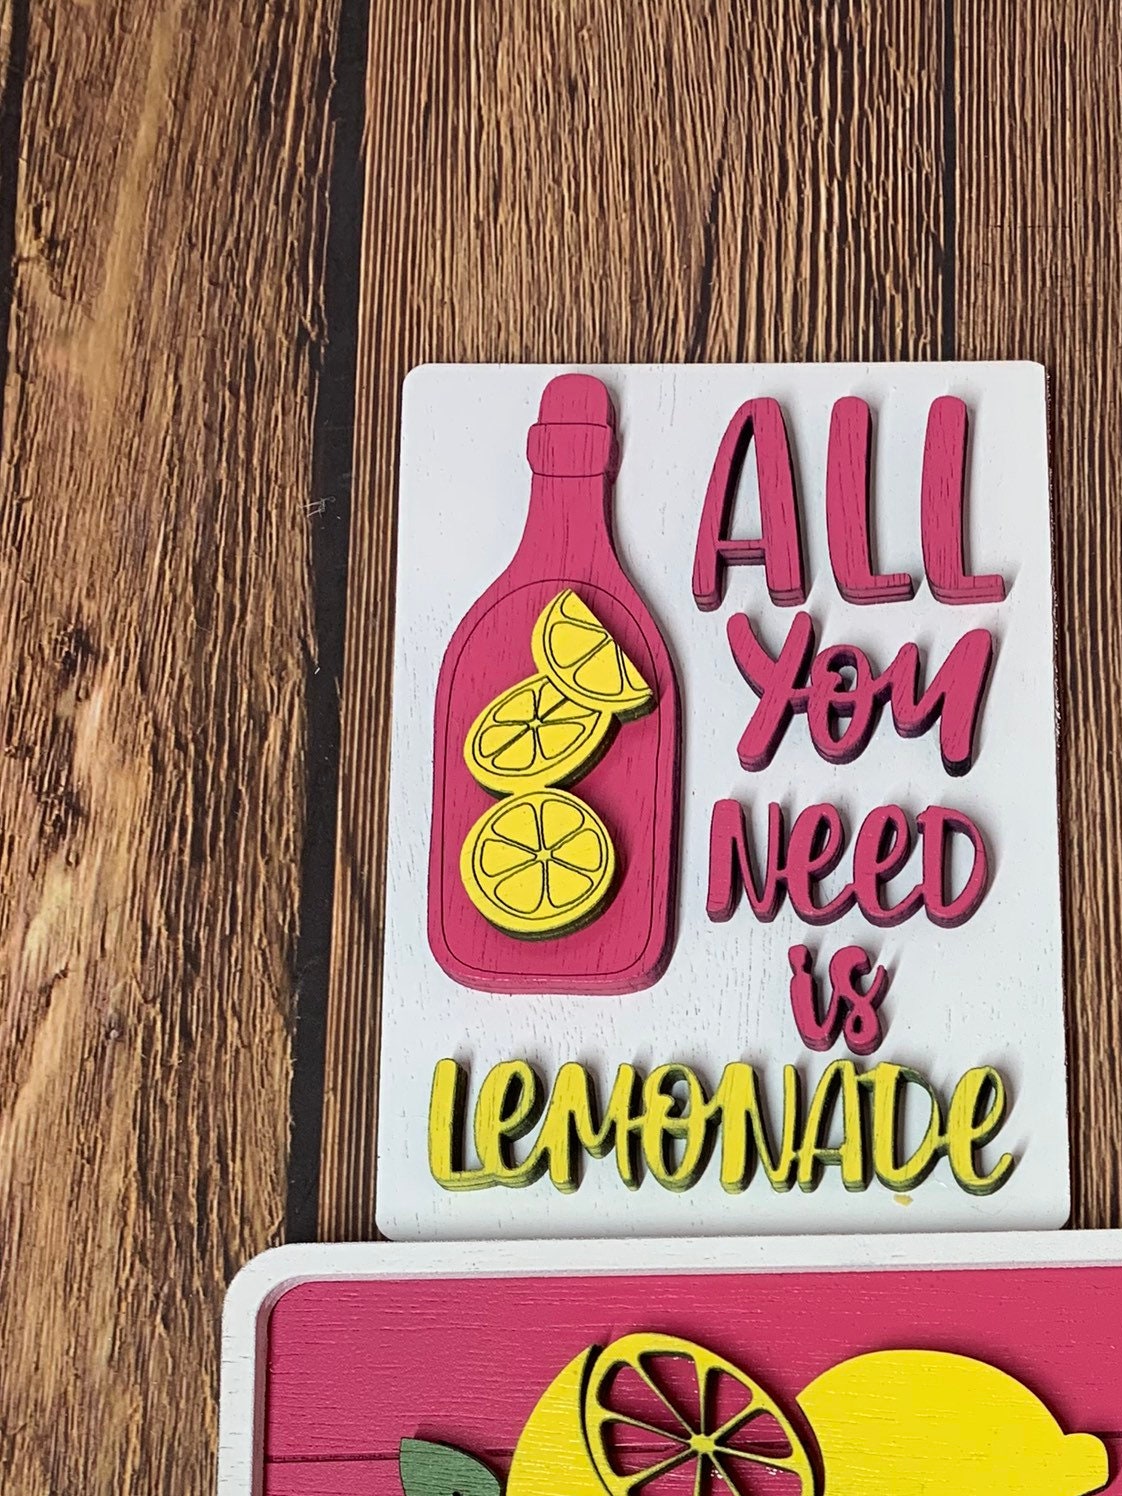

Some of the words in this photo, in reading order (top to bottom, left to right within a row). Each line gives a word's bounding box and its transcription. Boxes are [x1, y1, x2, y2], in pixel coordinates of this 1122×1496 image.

[691, 396, 1005, 611] ALL
[727, 611, 991, 777] You
[790, 943, 888, 1056] is
